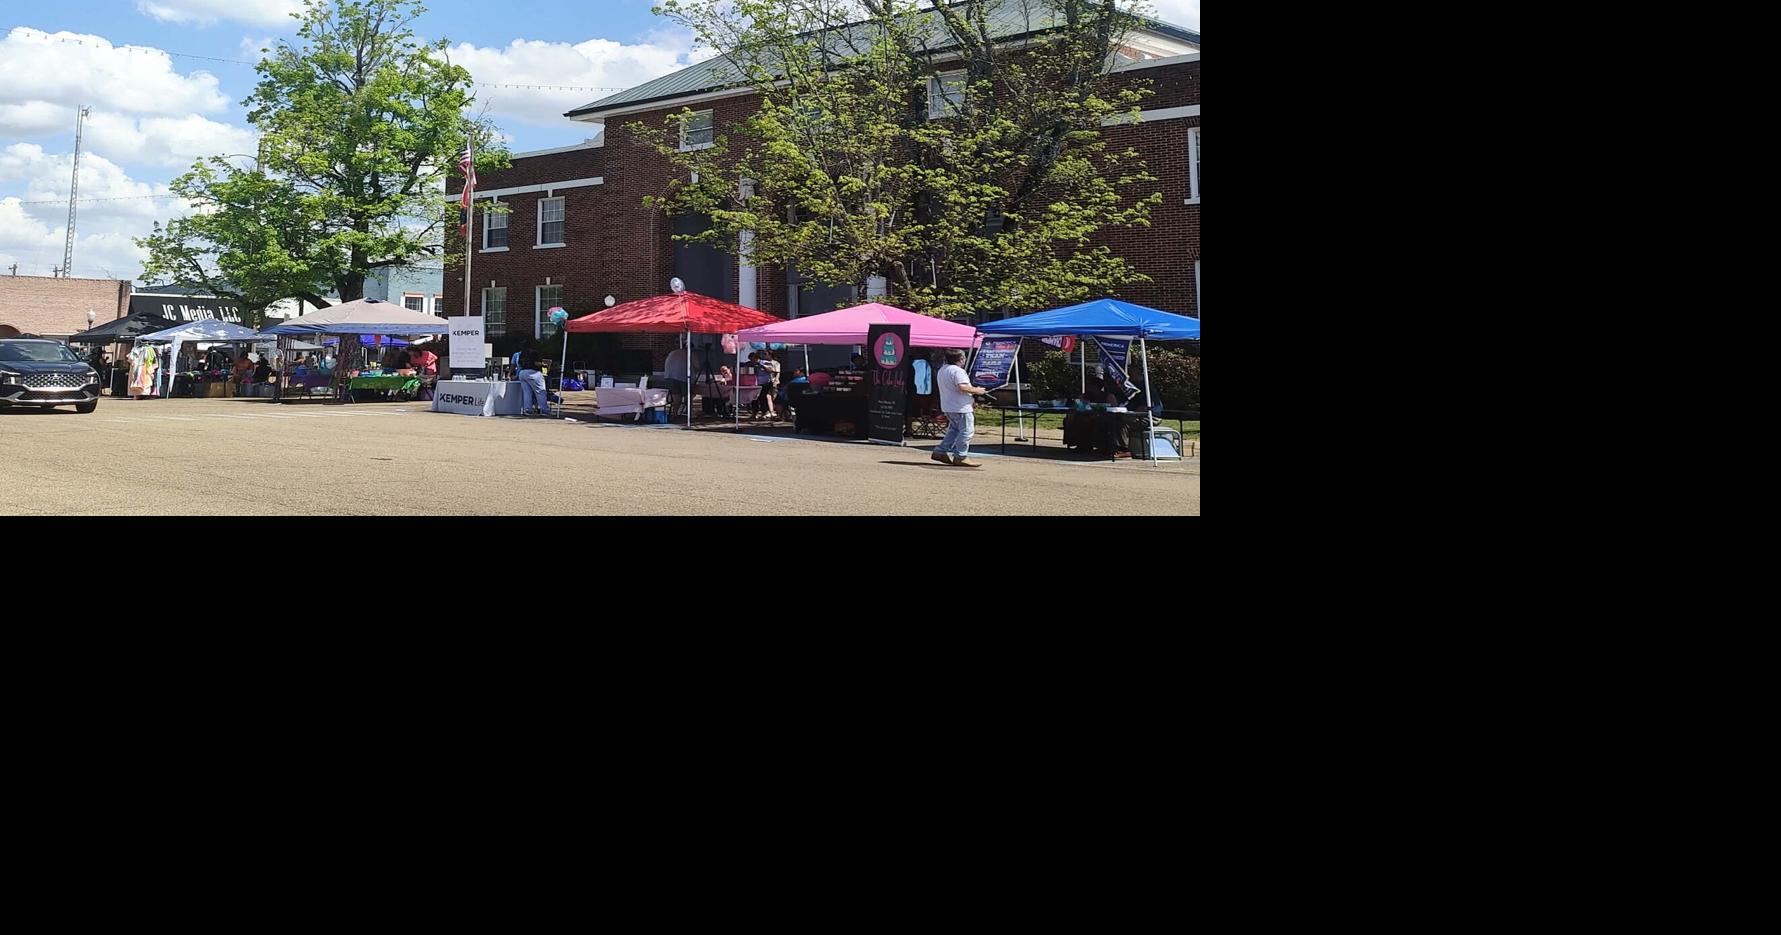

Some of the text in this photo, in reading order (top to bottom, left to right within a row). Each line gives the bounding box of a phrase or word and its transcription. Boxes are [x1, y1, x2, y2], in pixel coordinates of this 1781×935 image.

[162, 304, 177, 321] JC
[219, 306, 241, 323] LLC
[439, 393, 474, 406] KEMPER
